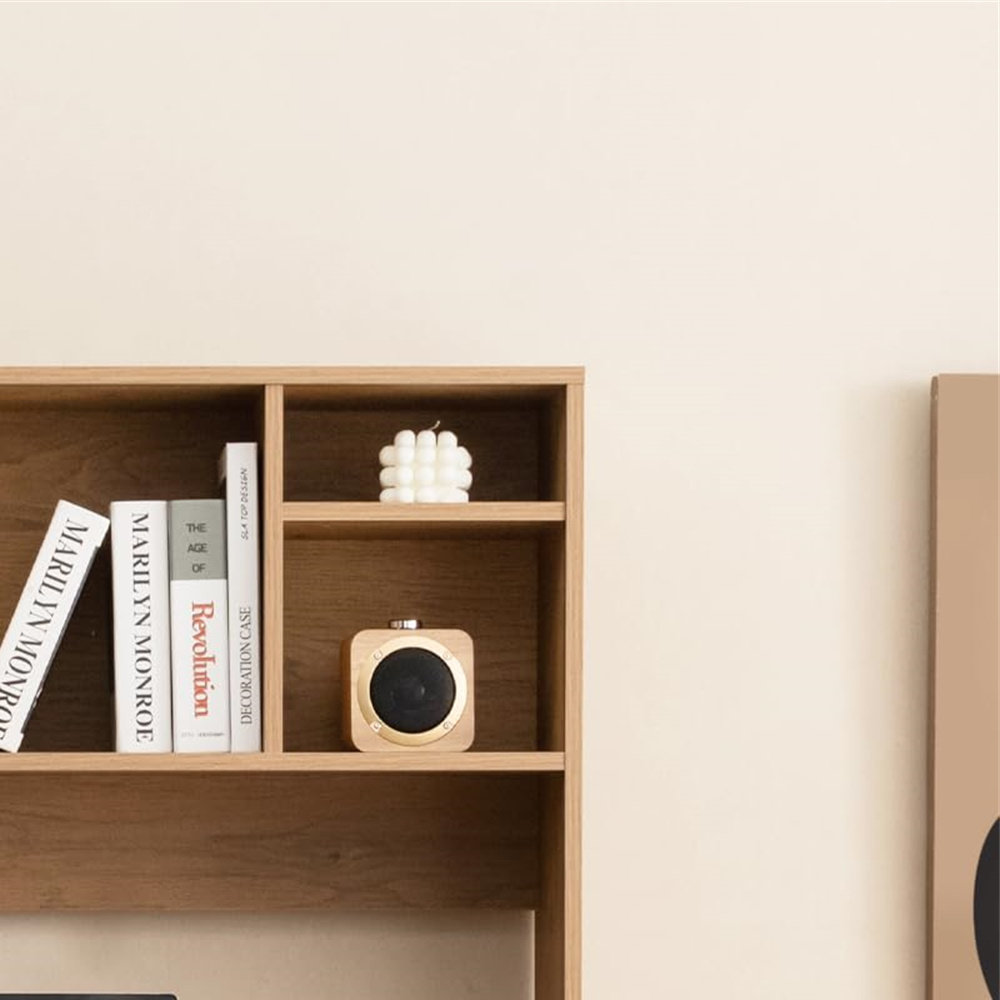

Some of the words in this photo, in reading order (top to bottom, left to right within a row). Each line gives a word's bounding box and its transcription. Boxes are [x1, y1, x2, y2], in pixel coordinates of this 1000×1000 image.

[239, 467, 249, 503] DESIGN
[186, 523, 207, 533] THE
[239, 523, 249, 541] SLA
[187, 543, 208, 554] AGE
[28, 518, 89, 636] MARILYN
[130, 512, 152, 628] MARILYN
[192, 563, 206, 574] OF
[239, 606, 252, 640] CASE
[191, 601, 216, 719] Revolution
[133, 635, 155, 744] MONROE
[239, 642, 253, 725] DECORATION
